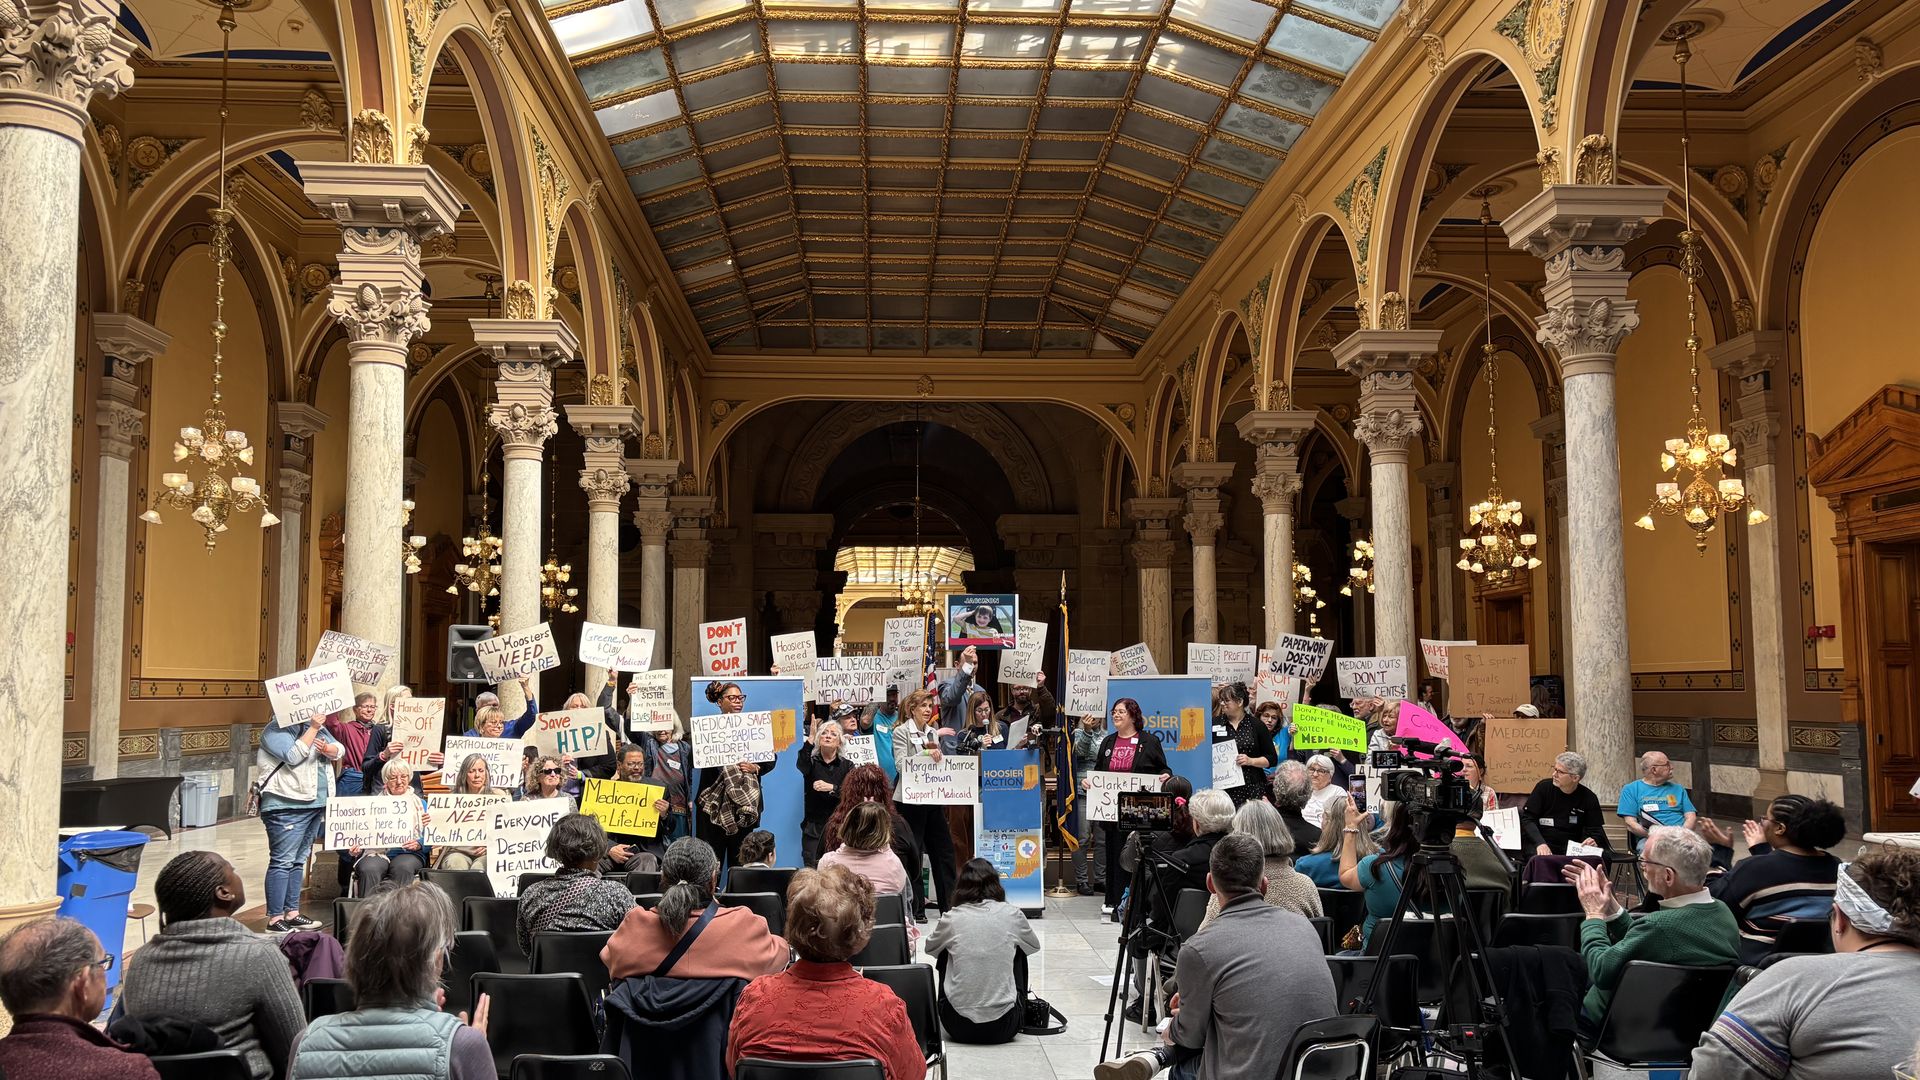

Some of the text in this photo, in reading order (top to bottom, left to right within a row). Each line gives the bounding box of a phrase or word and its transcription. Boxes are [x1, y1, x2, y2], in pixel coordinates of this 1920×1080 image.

[706, 622, 742, 639] DON'T
[887, 619, 923, 630] NO CUTS
[323, 630, 361, 649] HOOSIERS
[776, 640, 811, 653] Hoosiers
[1281, 635, 1328, 655] PAPERWORK
[320, 651, 328, 659] IN
[321, 640, 389, 664] 33 COUNTIES HERE
[477, 639, 501, 657] ALL
[602, 644, 622, 656] Clay
[709, 641, 737, 656] CUT
[785, 650, 808, 660] need
[1120, 645, 1145, 660] REGION
[1190, 649, 1216, 660] LIVES
[1224, 651, 1251, 661] PROFIT
[498, 644, 543, 668] NEED
[616, 657, 648, 667] Medicaid
[1069, 652, 1106, 665] Delaware
[1489, 657, 1520, 667] spent
[711, 657, 740, 671] OUR
[780, 661, 815, 673] ealthcare
[816, 659, 843, 672] ALLEN,
[1014, 659, 1028, 668] get
[1116, 655, 1145, 672] SUPPORTS
[1270, 661, 1297, 675] SAVE
[1339, 659, 1401, 670] MEDICAID CUTS
[821, 673, 851, 687] HOWARD
[853, 672, 886, 687] SUPPORT
[1003, 666, 1036, 679] Sicker
[1068, 671, 1101, 683] Madison
[1352, 670, 1387, 684] DON'T
[275, 682, 300, 694] Miami
[310, 671, 338, 684] Fulton
[1467, 674, 1499, 686] equals
[291, 688, 335, 705] SUPPORT
[641, 691, 665, 700] SYSTEM
[818, 686, 874, 703] MEDICAID!
[1072, 685, 1099, 697] Support
[1272, 690, 1289, 700] my
[1341, 686, 1367, 697] MAKE
[289, 698, 342, 723] MEDICAID
[397, 702, 423, 713] Hands
[1070, 698, 1103, 712] Medicaid
[538, 714, 571, 731] Save
[632, 711, 650, 721] LIVES
[692, 713, 771, 732] MEDICAID SAVES
[415, 717, 435, 731] Off
[1295, 723, 1324, 732] PROTECT
[1300, 714, 1323, 722] DON'T
[1337, 722, 1360, 733] HASTY
[556, 722, 602, 754] HIP!
[1490, 726, 1550, 739] MEDICAID
[407, 735, 425, 748] my
[447, 740, 515, 751] BARTHOLOMEW
[849, 737, 870, 745] CUTS
[1301, 733, 1358, 747] MEDICAID!
[703, 743, 749, 755] CHILDREN
[1507, 744, 1541, 753] SAVES
[400, 749, 429, 765] HIP
[742, 752, 773, 763] SENIORS
[1489, 757, 1512, 770] Lives
[905, 758, 976, 776] Morgan, Monroe
[983, 769, 1024, 778] HOOSIER
[924, 773, 952, 783] Brown
[984, 778, 1023, 786] ACTION
[1092, 776, 1122, 790] Clark
[584, 778, 649, 808] Medicaid
[904, 786, 972, 802] Support Medicaid
[329, 801, 408, 818] Hoosiers from 33
[428, 796, 507, 809] ALL Hoosiers
[446, 809, 486, 824] NEE
[494, 812, 559, 831] EVERYONE
[329, 817, 407, 832] counties here to
[333, 831, 413, 848] Protect Medicaid
[426, 826, 463, 843] Health
[496, 838, 546, 855] DESERV
